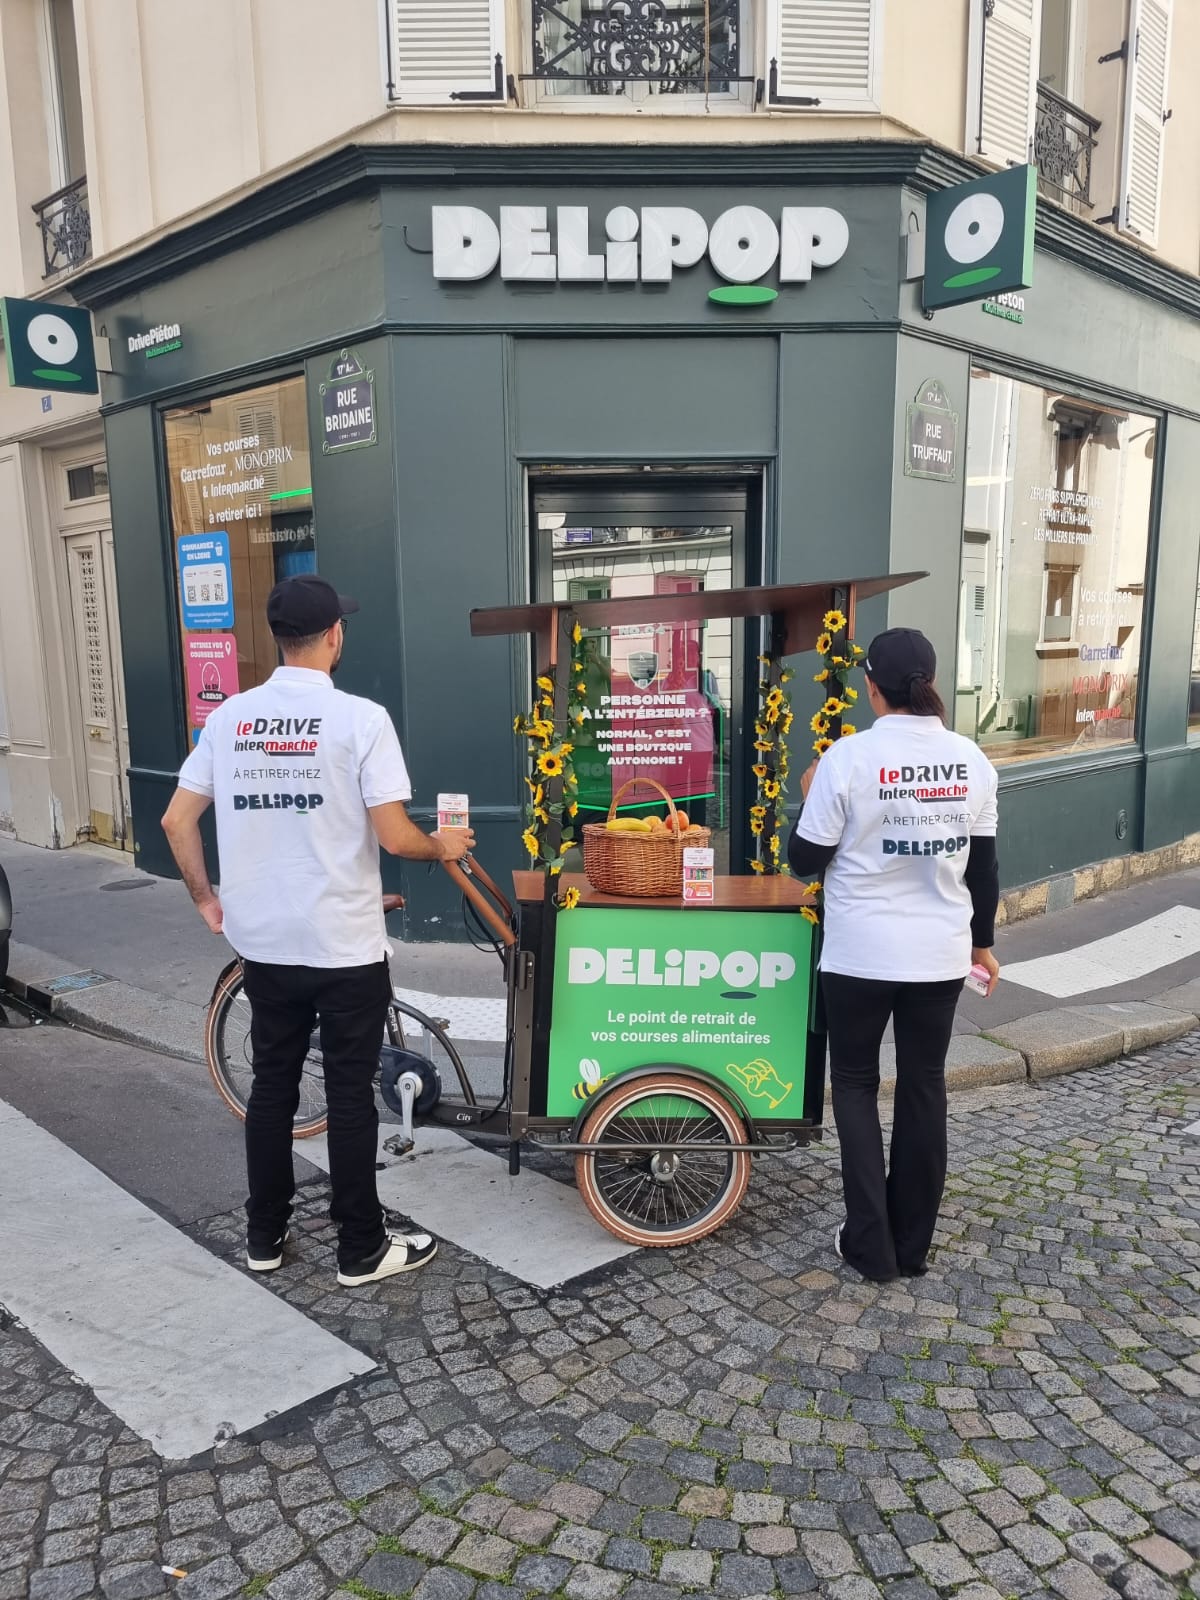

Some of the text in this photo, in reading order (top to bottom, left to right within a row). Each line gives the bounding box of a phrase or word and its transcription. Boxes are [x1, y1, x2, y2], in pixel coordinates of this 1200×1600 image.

[128, 323, 181, 353] DrivePiéton
[337, 387, 357, 408] RUE
[325, 406, 371, 432] BRIDAINE
[926, 422, 942, 439] RUE
[206, 434, 260, 456] Vos courses
[912, 443, 953, 465] TRUFFAUT
[180, 462, 227, 483] Carrefour
[234, 445, 293, 473] MONOPRIX
[211, 475, 265, 499] Intermarché
[209, 510, 215, 524] à
[216, 506, 244, 522] retirer
[245, 504, 257, 519] ici
[1080, 587, 1132, 602] Vos courses
[1080, 643, 1124, 661] Carrefour
[1072, 673, 1128, 695] MONOPRIX
[600, 694, 686, 705] PERSONNE
[583, 706, 592, 719] À
[594, 706, 695, 719] L'INTÉRIEUR
[596, 729, 691, 739] NORMAL, C'EST
[598, 742, 691, 752] UNE BOUTIQUE
[607, 757, 676, 765] AUTONOME
[233, 768, 321, 779] À RETIRER CHEZ
[882, 814, 891, 825] À
[893, 815, 941, 826] RETIRER
[608, 1010, 756, 1026] Le point de retrait de
[591, 1029, 771, 1044] vos courses alimentaires
